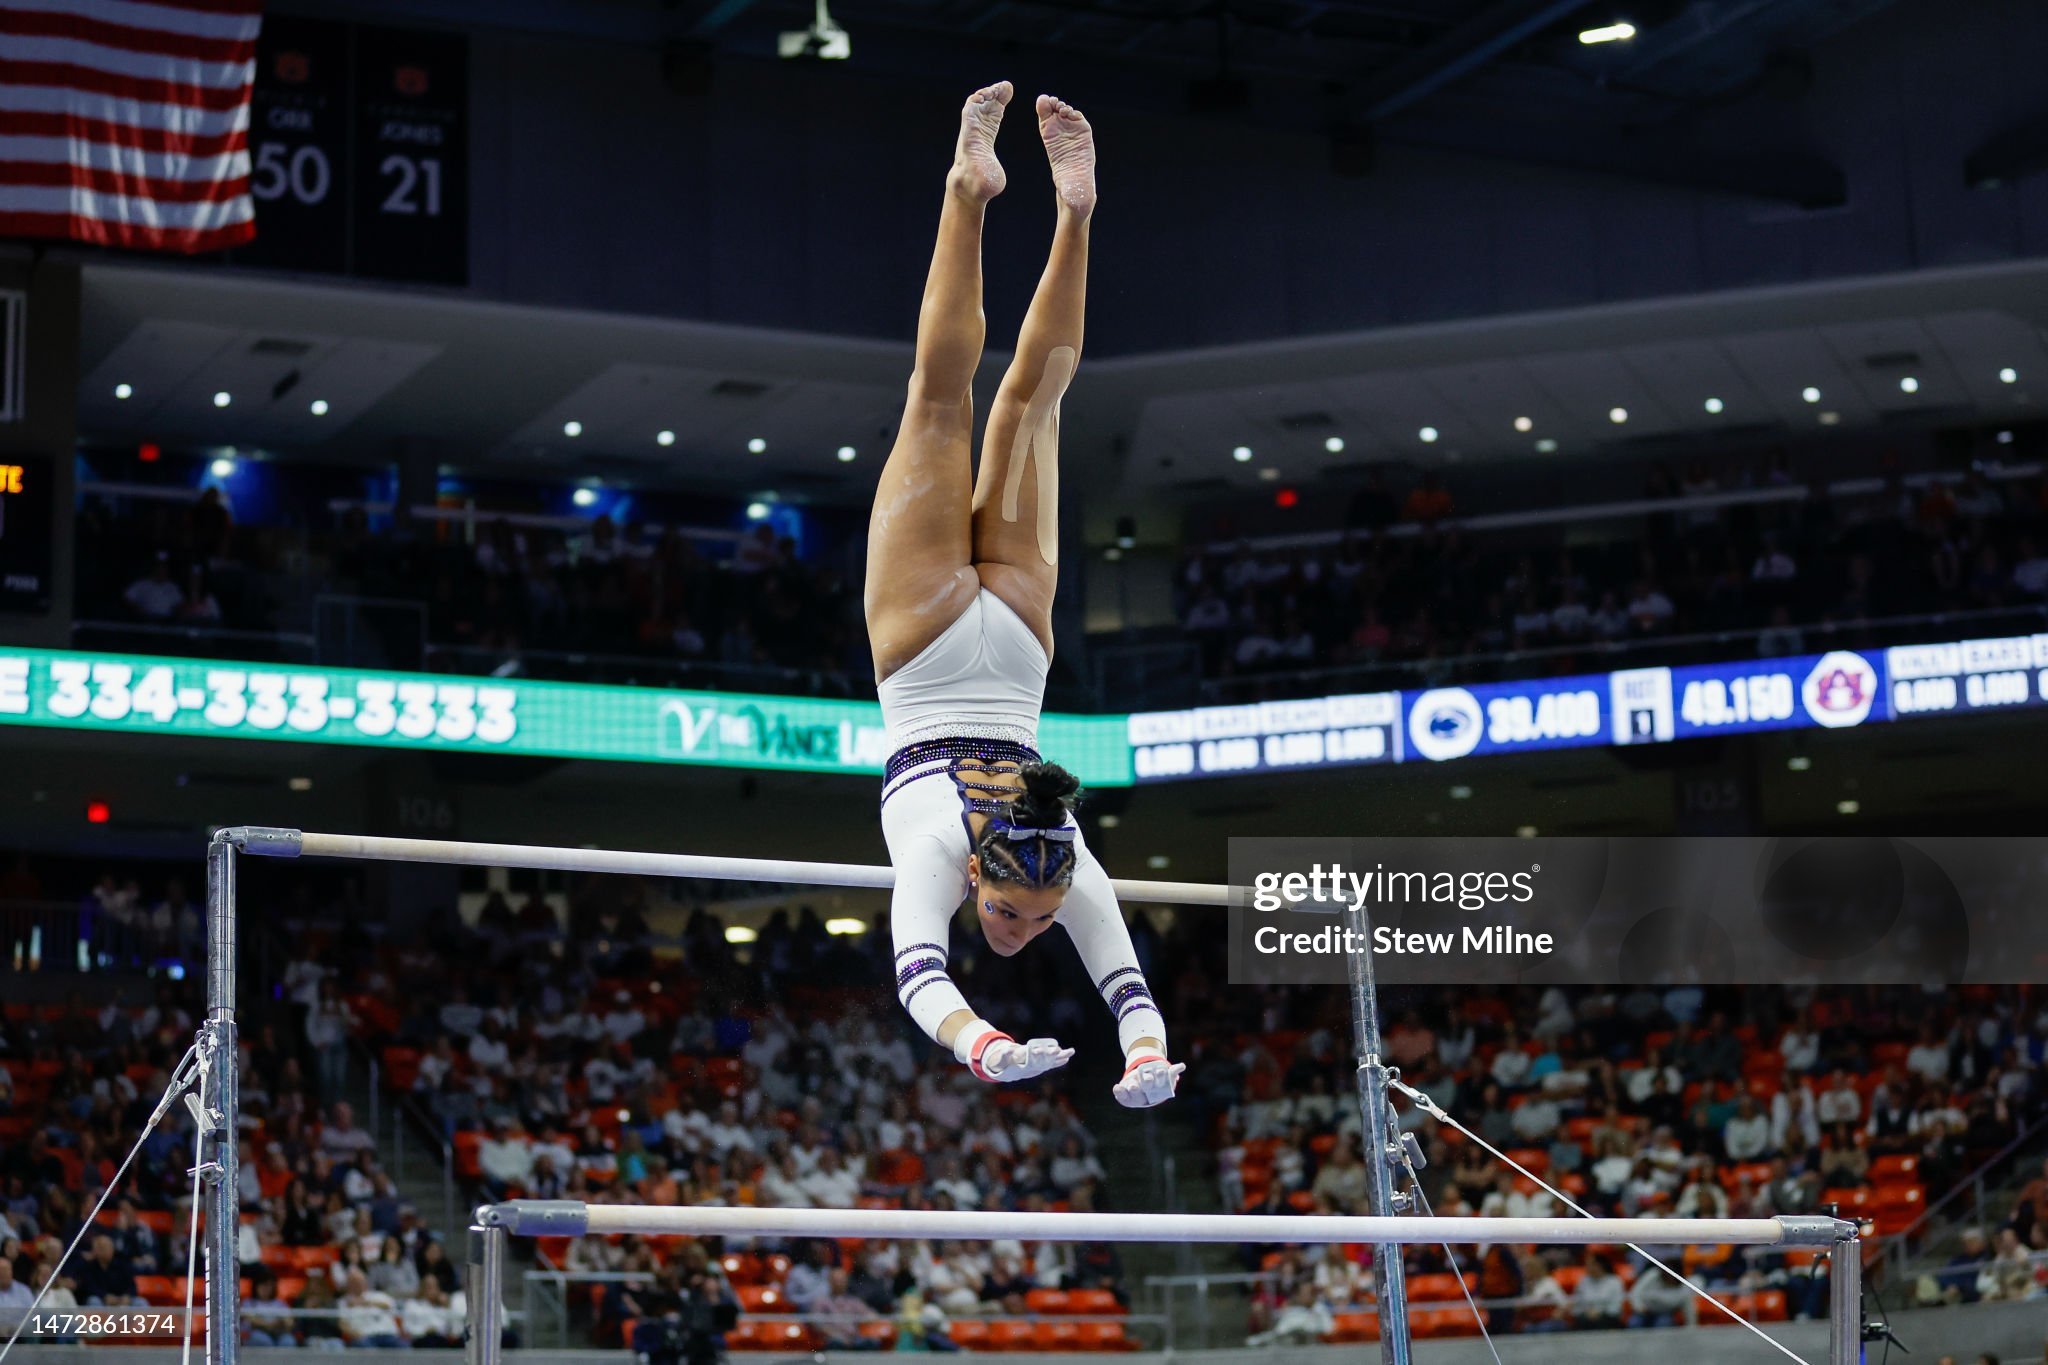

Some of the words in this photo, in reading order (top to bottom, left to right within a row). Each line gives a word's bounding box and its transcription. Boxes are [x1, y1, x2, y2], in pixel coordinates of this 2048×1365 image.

[251, 140, 331, 206] 50
[379, 153, 443, 218] 21
[48, 659, 517, 745] 334-333-3333
[1682, 674, 1793, 726] 49.150
